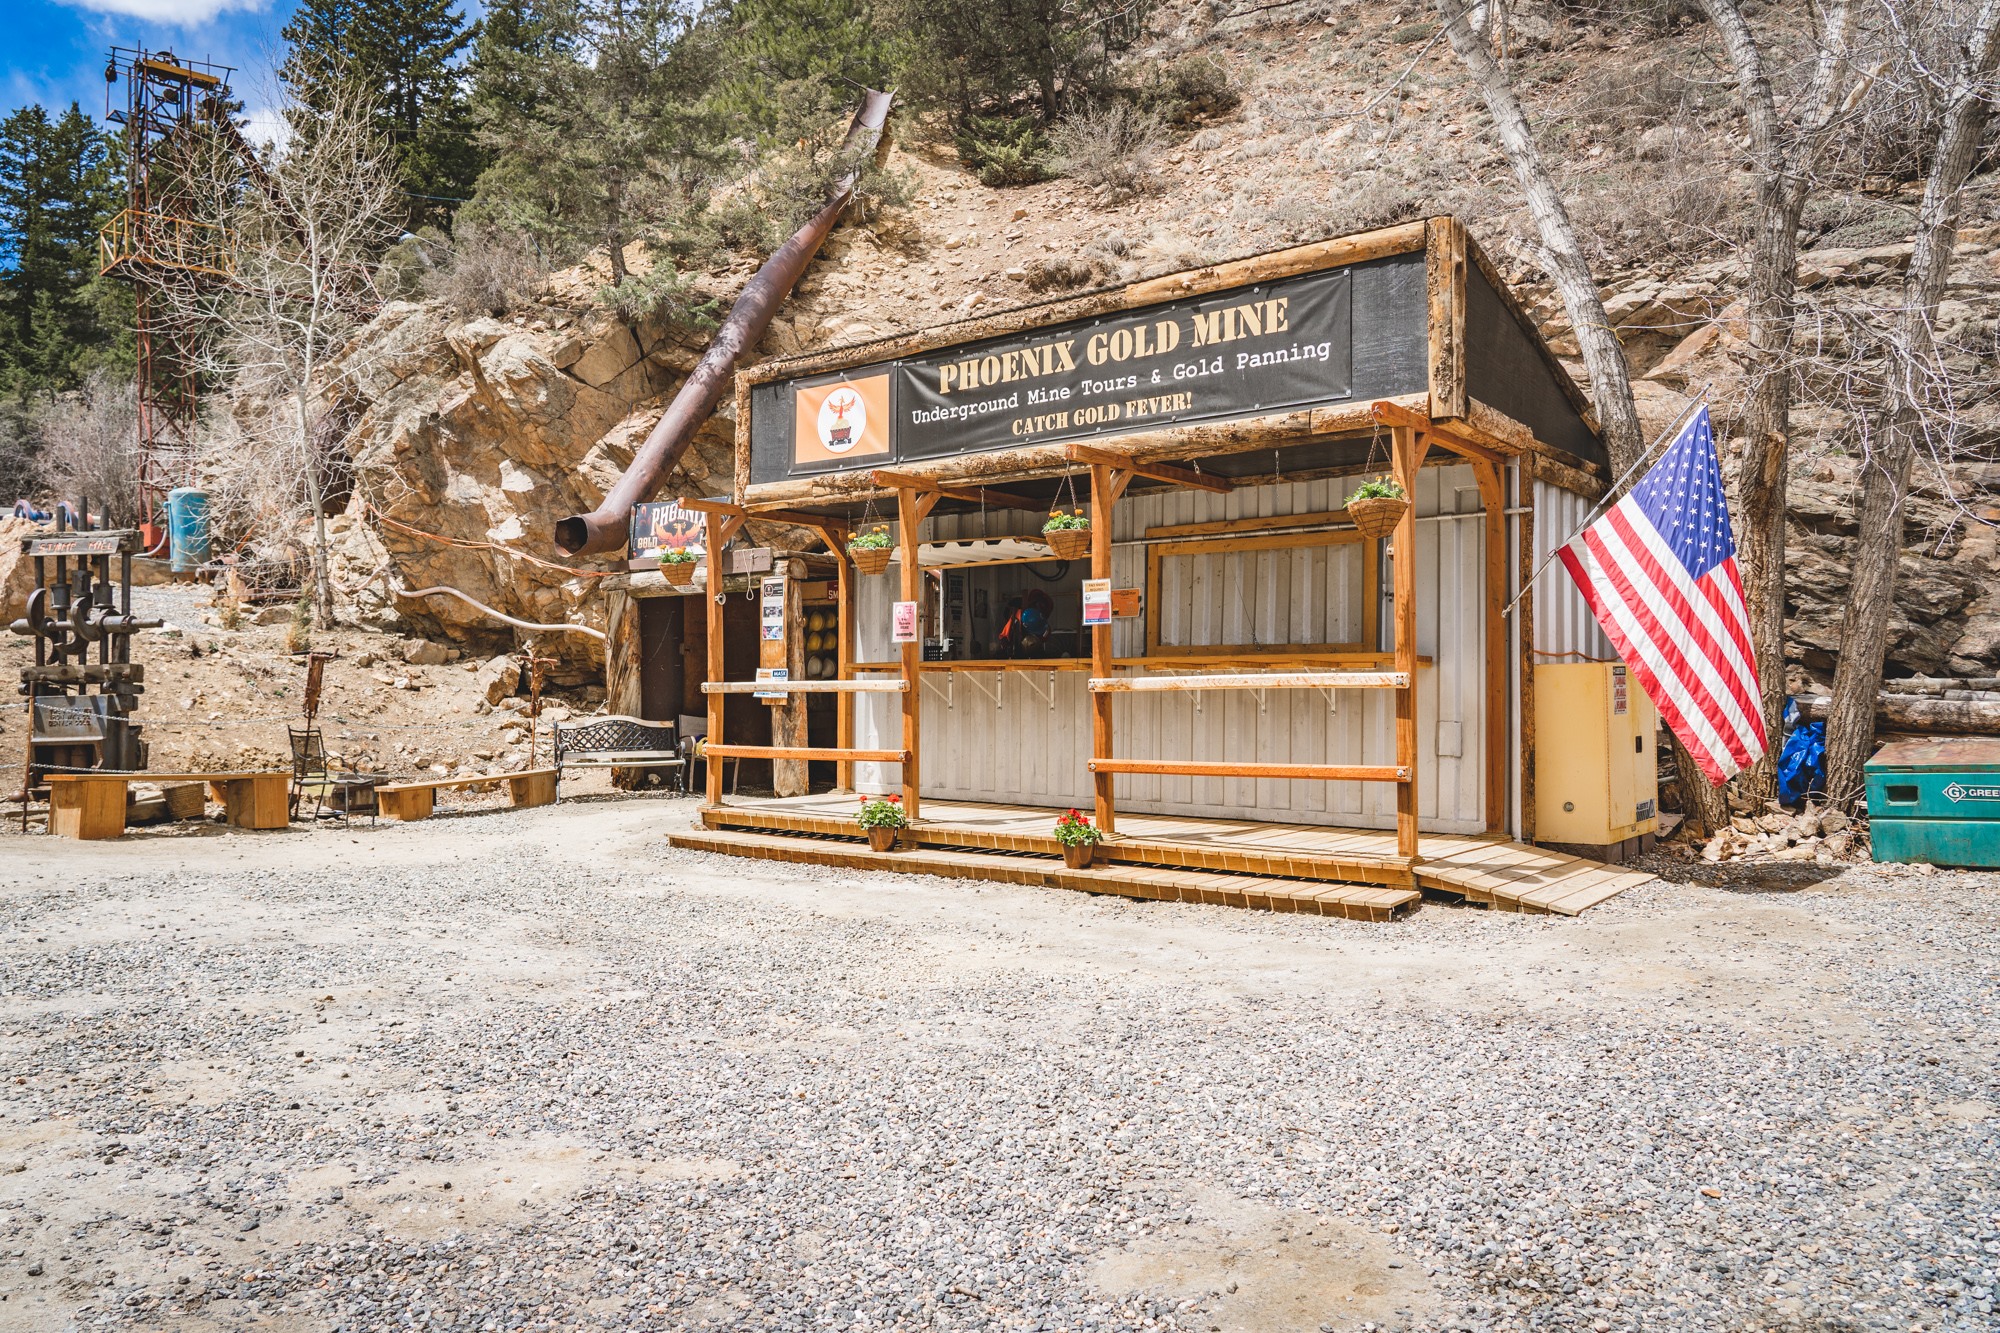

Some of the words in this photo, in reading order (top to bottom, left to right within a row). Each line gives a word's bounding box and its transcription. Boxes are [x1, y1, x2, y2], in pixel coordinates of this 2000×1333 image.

[939, 339, 1076, 394] PHOENIX
[1087, 320, 1180, 366] GOLD
[1192, 297, 1288, 347] MINE
[912, 392, 1019, 424] Underground
[1027, 387, 1071, 405] Mine
[1081, 374, 1137, 396] Tours
[1151, 369, 1161, 384] &
[1173, 356, 1224, 380] Gold
[1236, 342, 1331, 370] Panning
[1012, 411, 1069, 436] CATCH
[1073, 405, 1120, 426] GOLD
[1126, 391, 1192, 418] FEVER!
[38, 542, 77, 552] STAMP
[637, 536, 658, 549] GOLD
[1948, 787, 1960, 798] G
